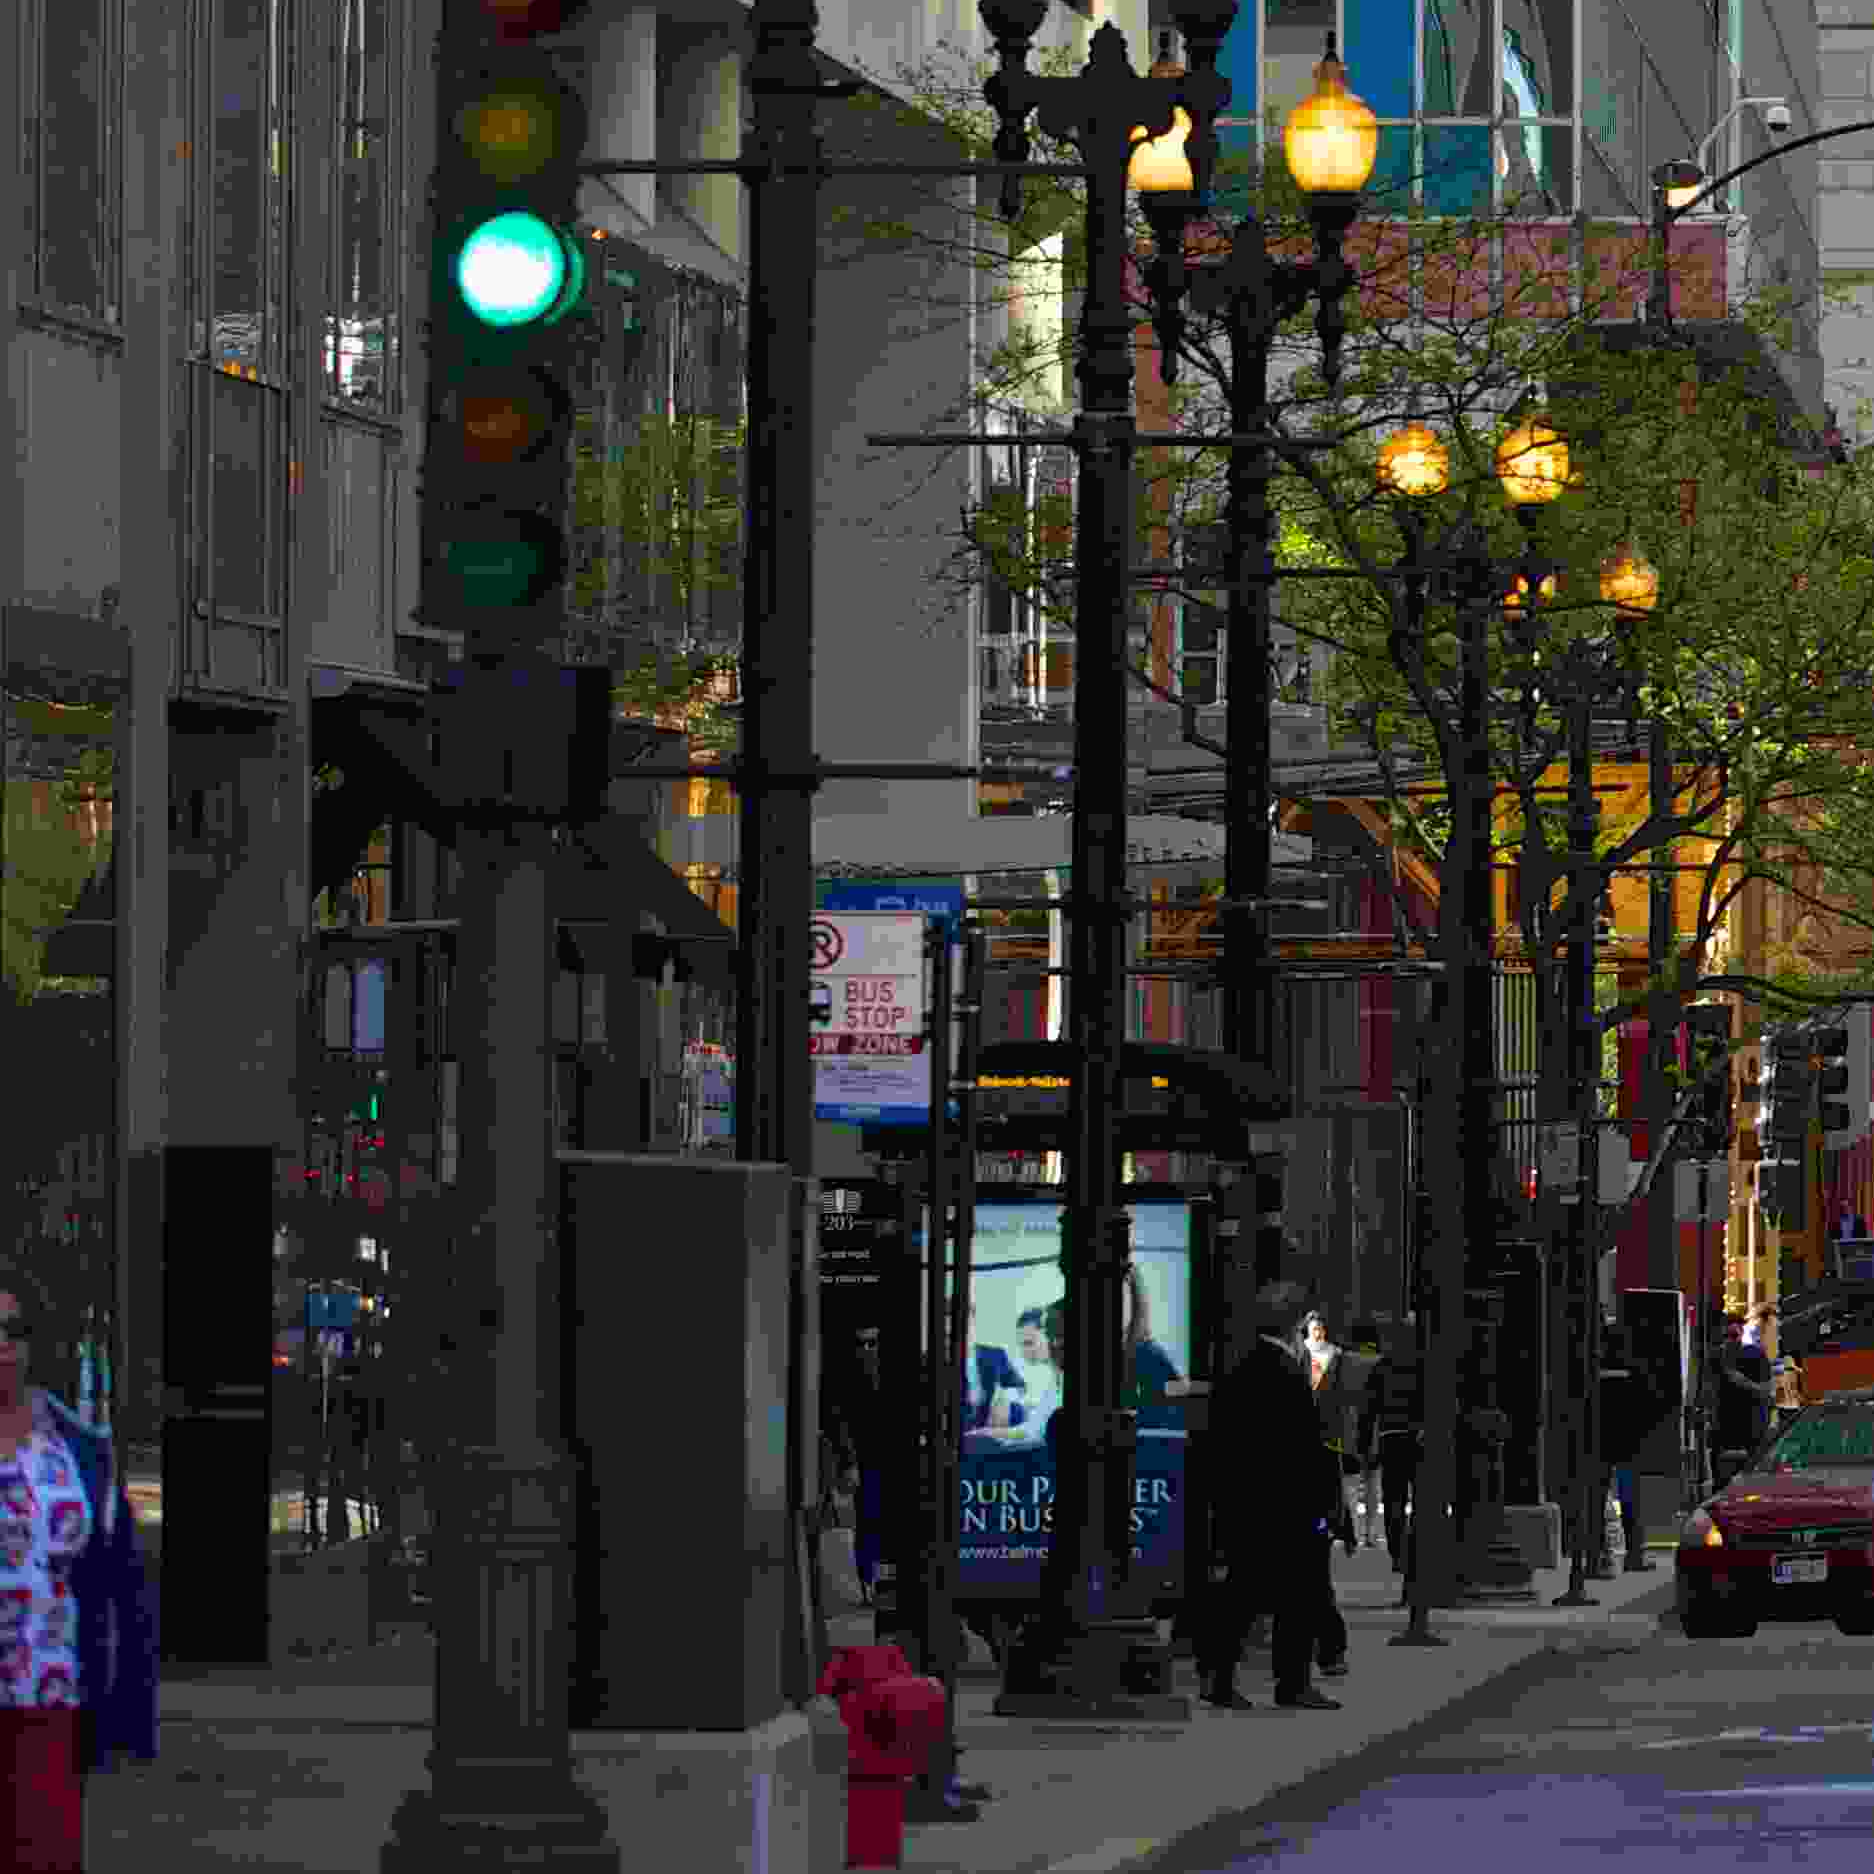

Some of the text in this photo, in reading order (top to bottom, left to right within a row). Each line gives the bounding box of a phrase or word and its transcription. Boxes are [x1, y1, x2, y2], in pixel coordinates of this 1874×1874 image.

[845, 981, 894, 1003] BUS
[845, 1005, 906, 1029] STOP
[855, 1036, 912, 1054] ZONE
[959, 1478, 1022, 1504] OUR
